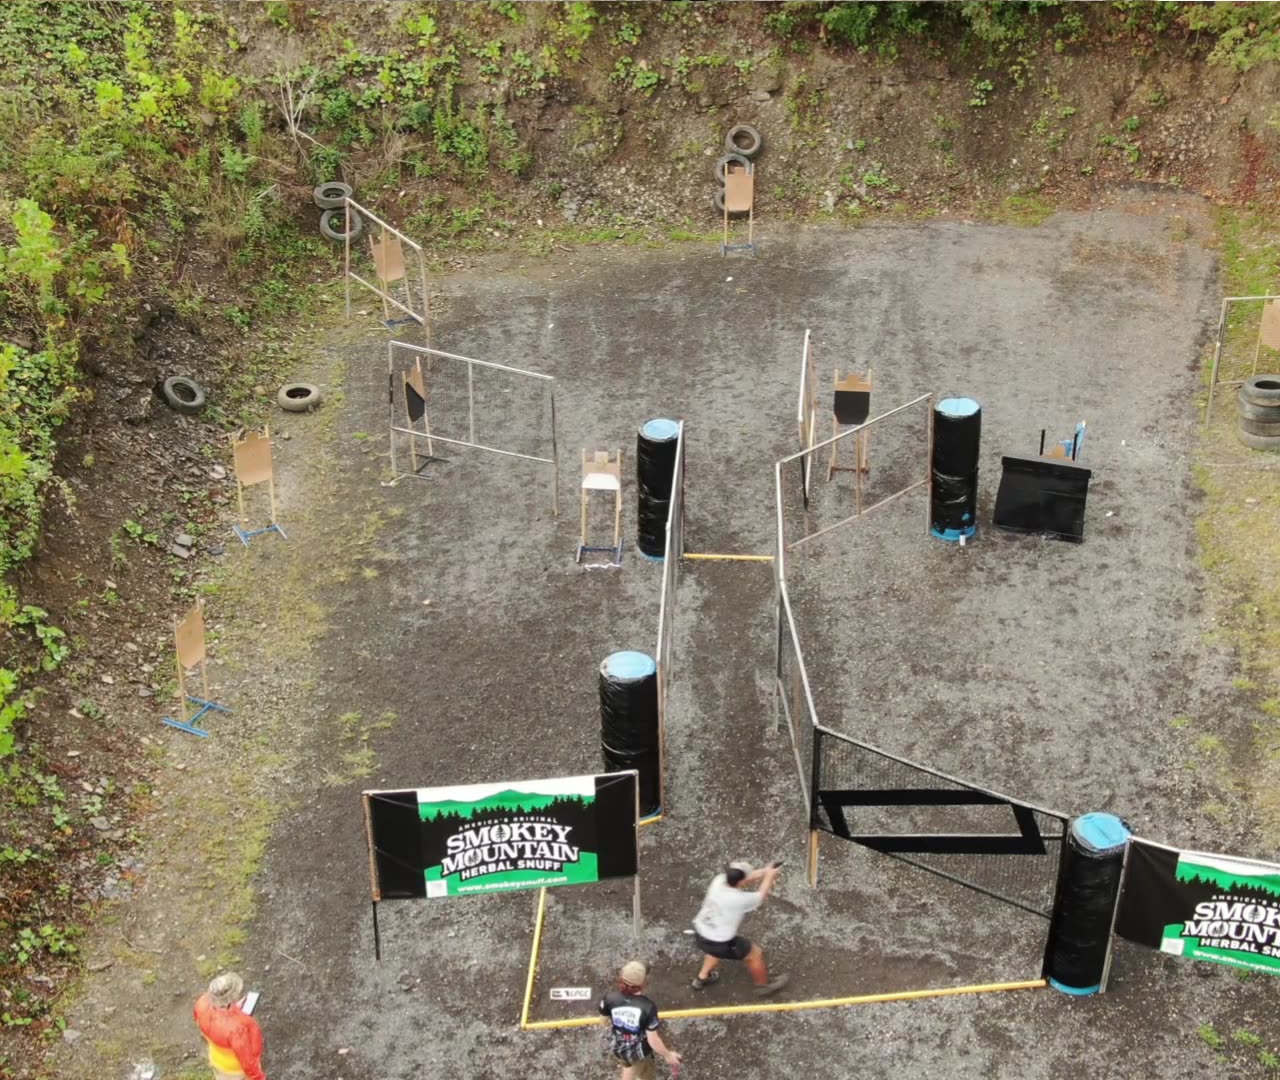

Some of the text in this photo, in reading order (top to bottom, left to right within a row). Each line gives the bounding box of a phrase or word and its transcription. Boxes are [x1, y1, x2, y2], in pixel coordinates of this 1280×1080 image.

[447, 822, 572, 855] SMOKEY
[441, 841, 579, 875] MOUNTAIN
[462, 859, 561, 880] HERBAL SNUFF
[1201, 938, 1258, 952] HERBAL
